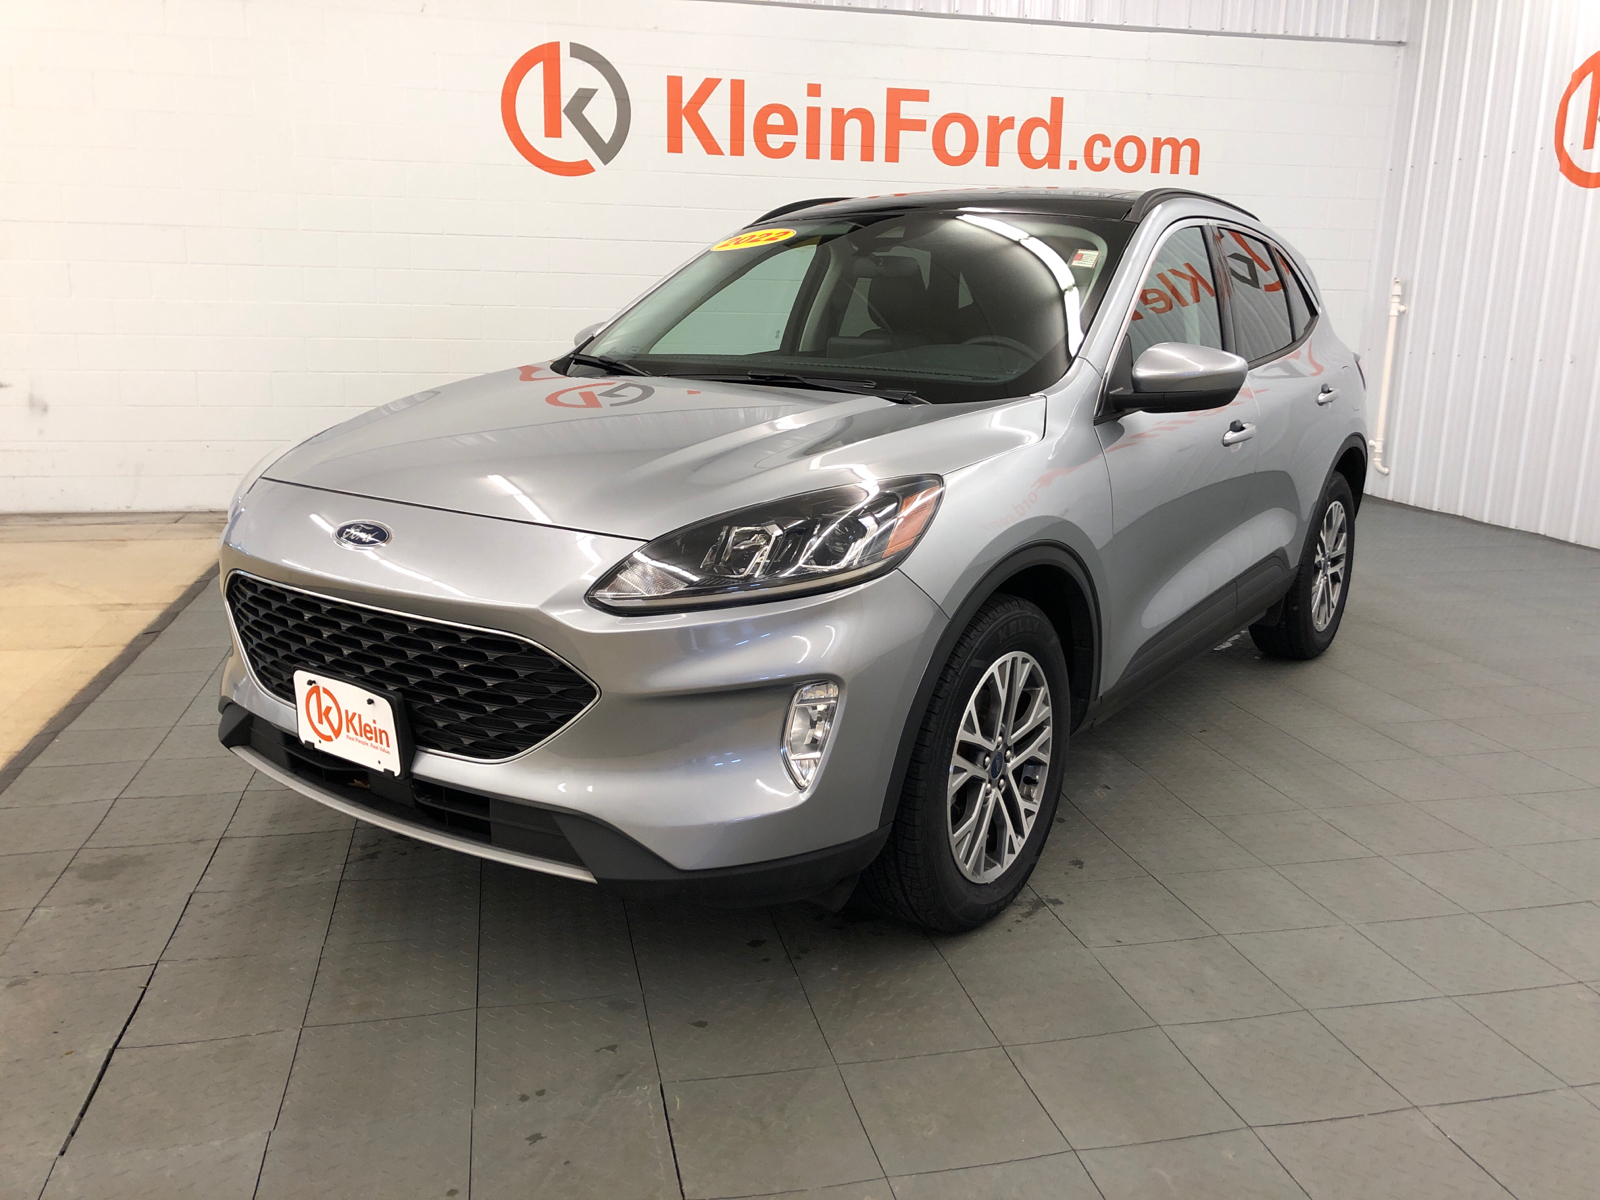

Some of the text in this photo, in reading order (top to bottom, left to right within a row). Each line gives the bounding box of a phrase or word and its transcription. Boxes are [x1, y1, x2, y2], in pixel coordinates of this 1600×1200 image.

[667, 75, 1200, 176] KleinFord.com
[716, 231, 791, 248] 2022
[344, 709, 390, 748] Klein
